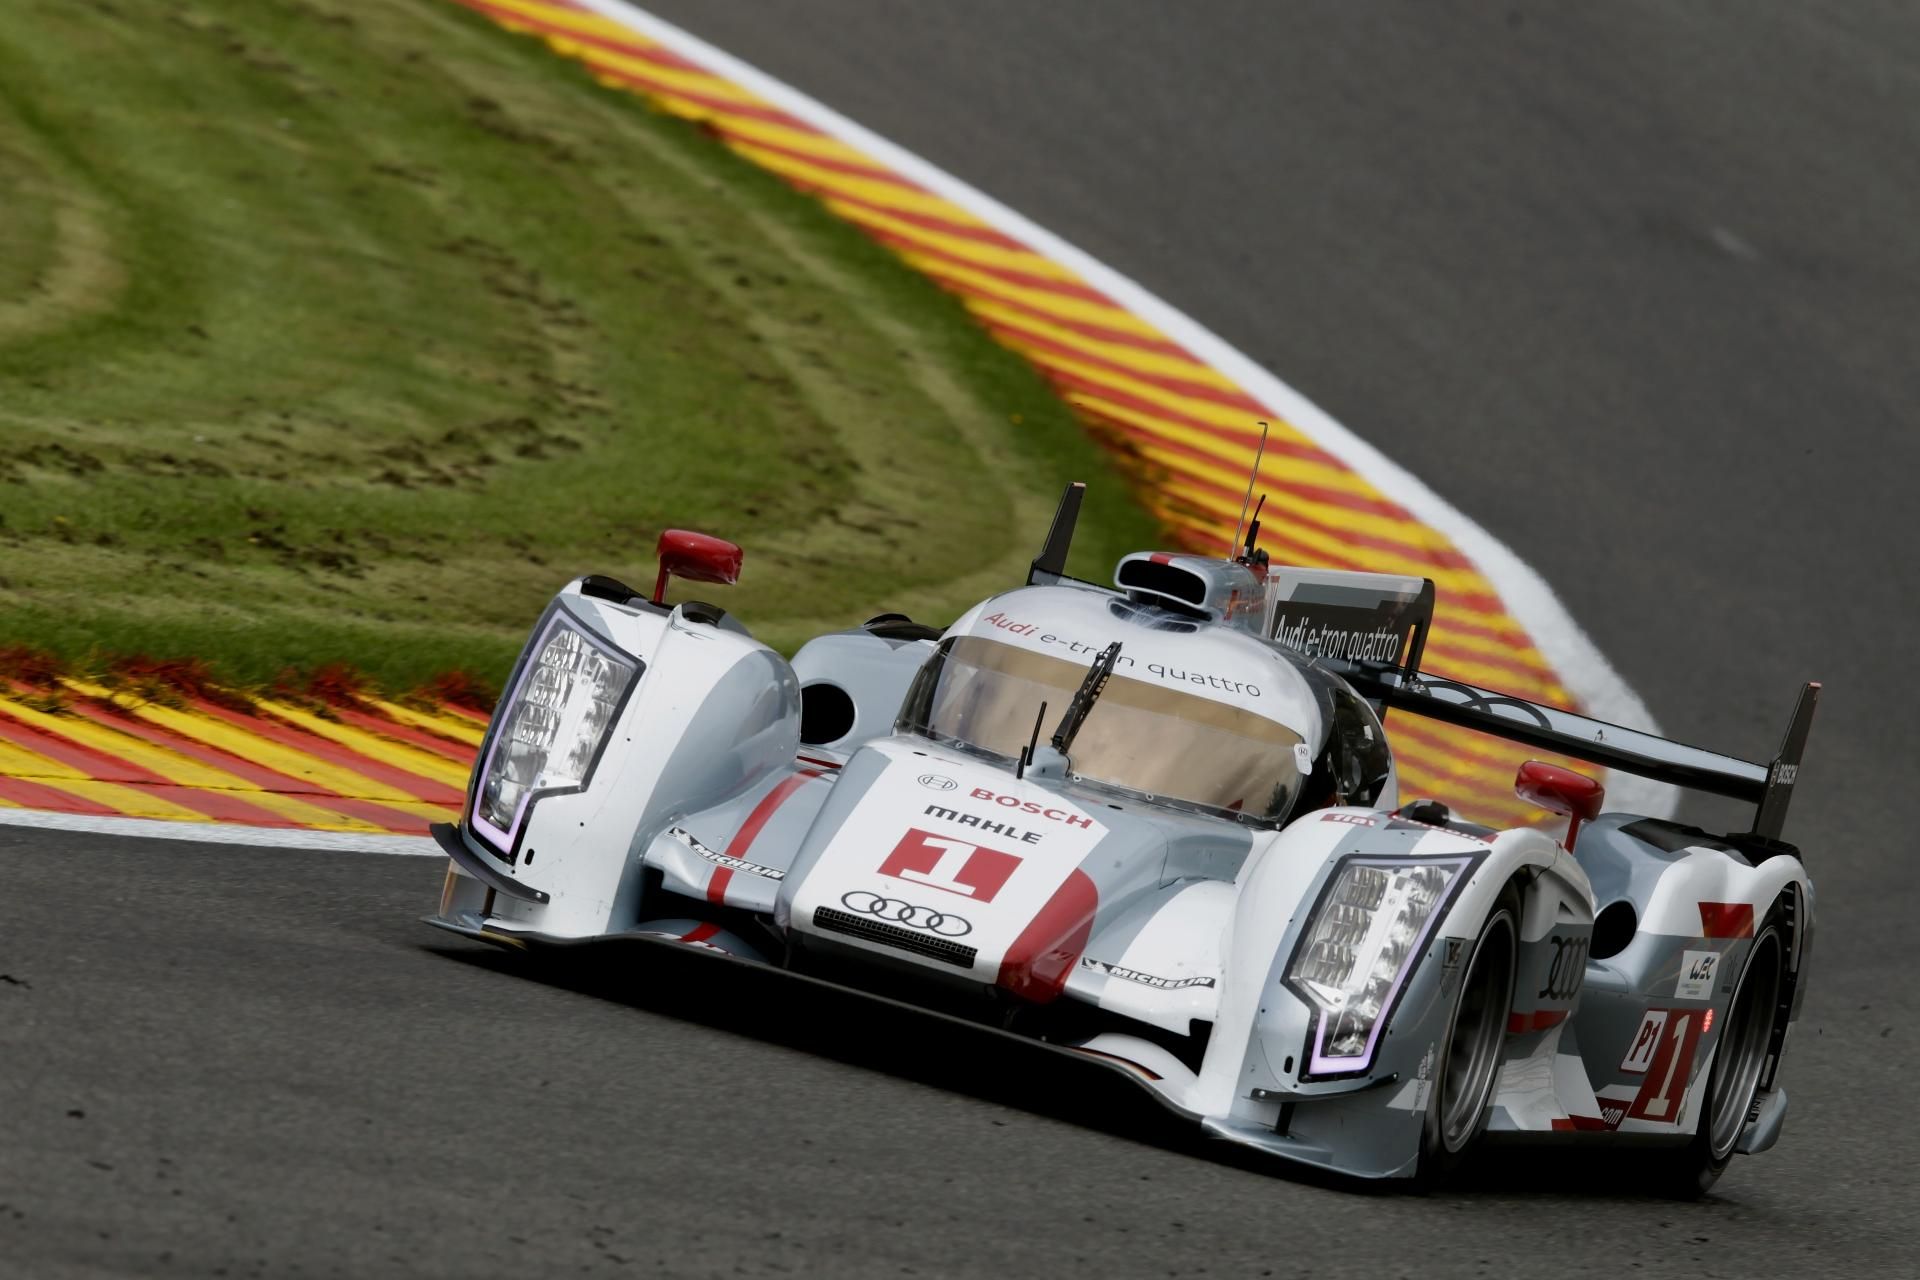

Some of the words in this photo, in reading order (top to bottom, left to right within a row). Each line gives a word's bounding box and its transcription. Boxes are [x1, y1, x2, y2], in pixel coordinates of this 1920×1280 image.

[984, 612, 1040, 636] Audi
[1147, 662, 1261, 697] quattro
[1274, 615, 1309, 651] Audi
[1306, 624, 1347, 659] e-tron
[1348, 625, 1400, 669] quattro
[1777, 763, 1798, 785] BOSCH
[924, 805, 1042, 845] MAHLE
[969, 788, 1093, 829] BOSCH
[694, 844, 785, 879] MICHELIN
[899, 836, 978, 896] 1
[1110, 966, 1212, 988] MICHELIN
[1689, 956, 1716, 981] WEC
[1629, 1020, 1662, 1063] P1
[1643, 1014, 1691, 1117] 1
